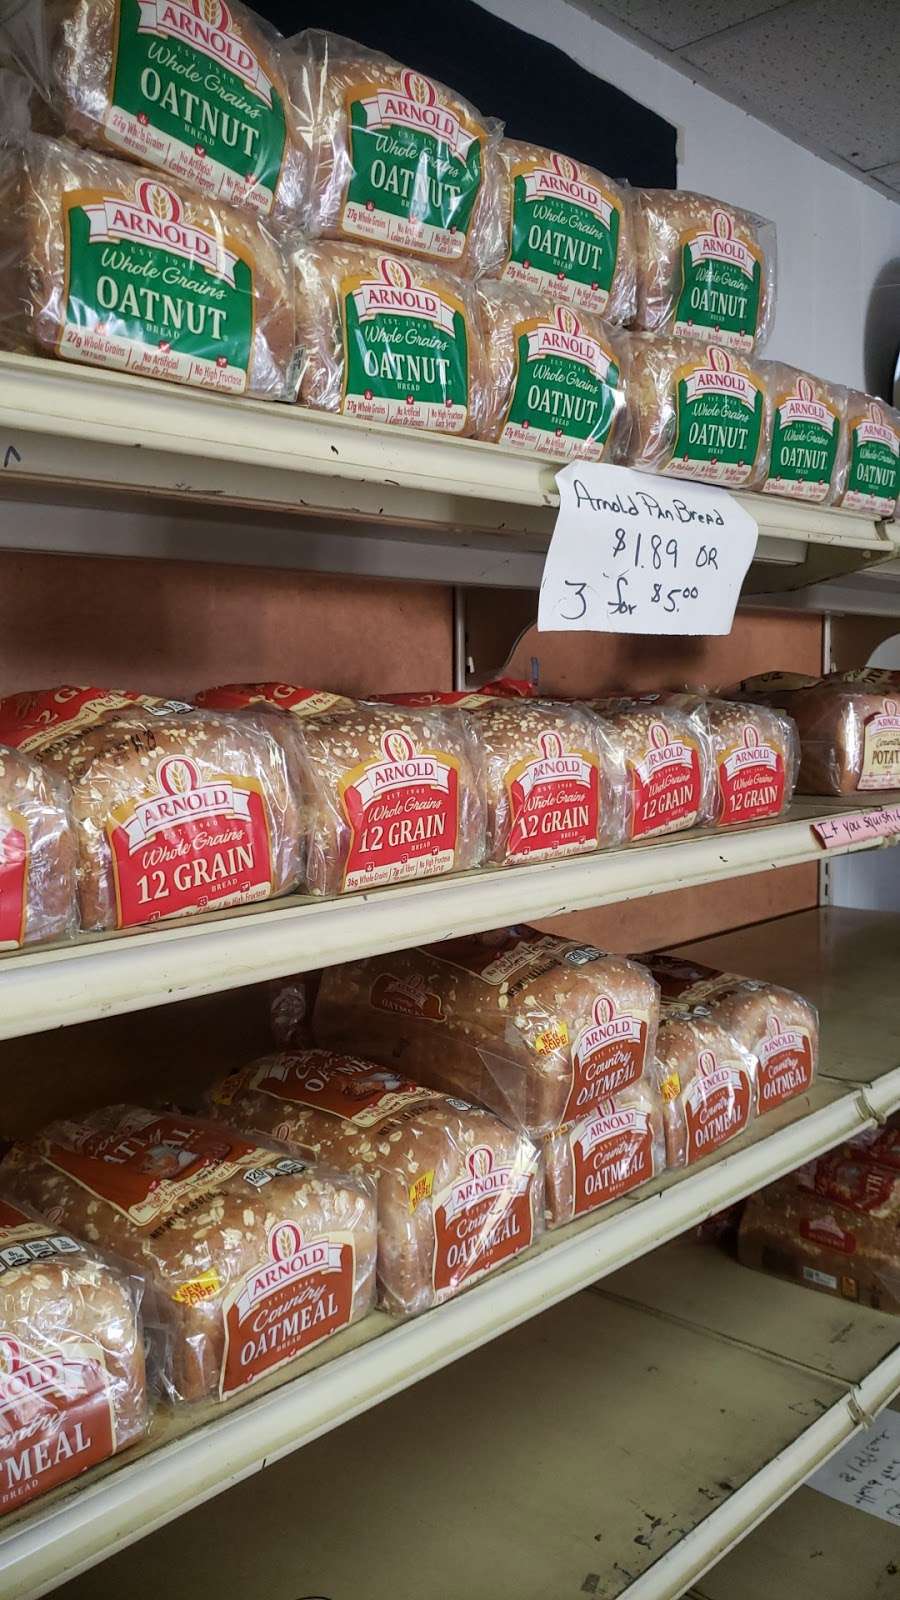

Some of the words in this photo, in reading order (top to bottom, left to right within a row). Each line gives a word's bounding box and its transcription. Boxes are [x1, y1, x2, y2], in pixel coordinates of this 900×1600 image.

[161, 12, 254, 71] ARNOLD
[148, 42, 202, 83] Whole
[204, 75, 262, 119] Grains
[141, 68, 259, 157] OATNUT
[384, 99, 455, 136] ARNOLD
[184, 124, 215, 147] BREAD
[375, 135, 418, 159] Whole
[370, 160, 461, 211] OATUT
[539, 175, 597, 205] ARNOLD
[112, 209, 211, 256] ARNOLD
[533, 204, 567, 225] Whole
[568, 214, 604, 240] Grains
[528, 225, 603, 271] OATNUT
[702, 239, 745, 260] ARNOLD
[101, 247, 160, 281] Whole
[162, 266, 227, 300] Grains
[721, 271, 749, 291] Grains
[96, 275, 227, 340] OATNUT
[368, 289, 437, 312] ARNOLD
[691, 287, 748, 319] OATNUT
[66, 330, 82, 348] 27g
[83, 335, 105, 350] Whole
[105, 339, 126, 357] Grains
[146, 323, 181, 340] BREAD
[364, 326, 404, 343] Whole
[405, 328, 448, 352] Grains
[542, 332, 595, 359] ARNOLD
[143, 351, 152, 362] No
[152, 353, 179, 371] Artificial
[363, 349, 450, 385] OATNUT
[532, 363, 565, 383] Whole
[566, 371, 599, 395] Grains
[697, 373, 746, 391] ARNOLD
[527, 385, 598, 424] OATNUT
[692, 403, 720, 417] Whole
[720, 405, 750, 422] Grains
[788, 403, 825, 419] ARNOLD
[688, 422, 748, 450] OATNUT
[780, 446, 828, 470] OATNUT
[856, 463, 896, 488] OATNUT
[573, 479, 640, 516] Arnold
[613, 528, 679, 570] $1.89
[695, 544, 719, 570] OR
[560, 580, 587, 620] 3
[607, 577, 638, 615] for
[650, 583, 699, 613] $5.00
[533, 760, 580, 777] ARNOLD
[649, 746, 683, 766] RNOLD
[735, 749, 769, 764] ARNOLD
[375, 763, 434, 786] ARNOLD
[144, 790, 229, 826] ARNOLD
[368, 800, 402, 823] Whole
[404, 796, 442, 813] Grains
[523, 793, 555, 813] Whole
[556, 790, 586, 804] Grains
[642, 799, 657, 821] 12
[658, 784, 694, 814] GRAIN
[730, 793, 743, 812] 12
[744, 785, 778, 808] GRAIN
[358, 826, 385, 853] 12
[388, 812, 447, 847] GRAIN
[517, 815, 539, 840] 12
[541, 805, 590, 834] GRAIN
[817, 820, 838, 840] If
[843, 819, 861, 839] you
[142, 839, 191, 870] Whole
[192, 829, 245, 850] Grains
[136, 870, 170, 905] 12
[173, 843, 255, 891] GRAIN
[211, 878, 237, 893] BREAD
[585, 1021, 631, 1050] ARNOLD
[763, 1034, 796, 1053] ARNOLD
[586, 1050, 633, 1081] Country
[576, 1060, 635, 1106] OATMEAL
[763, 1066, 808, 1099] OATMEAL
[695, 1105, 743, 1148] OATMEAL
[457, 1173, 509, 1202] ARNOLD
[252, 1248, 325, 1296] ARNOLD
[252, 1283, 328, 1334] Country
[240, 1292, 339, 1367] OATMEAL
[276, 1335, 302, 1353] BREAD
[0, 1422, 91, 1489] MEAL
[3, 1478, 39, 1503] BREAD
